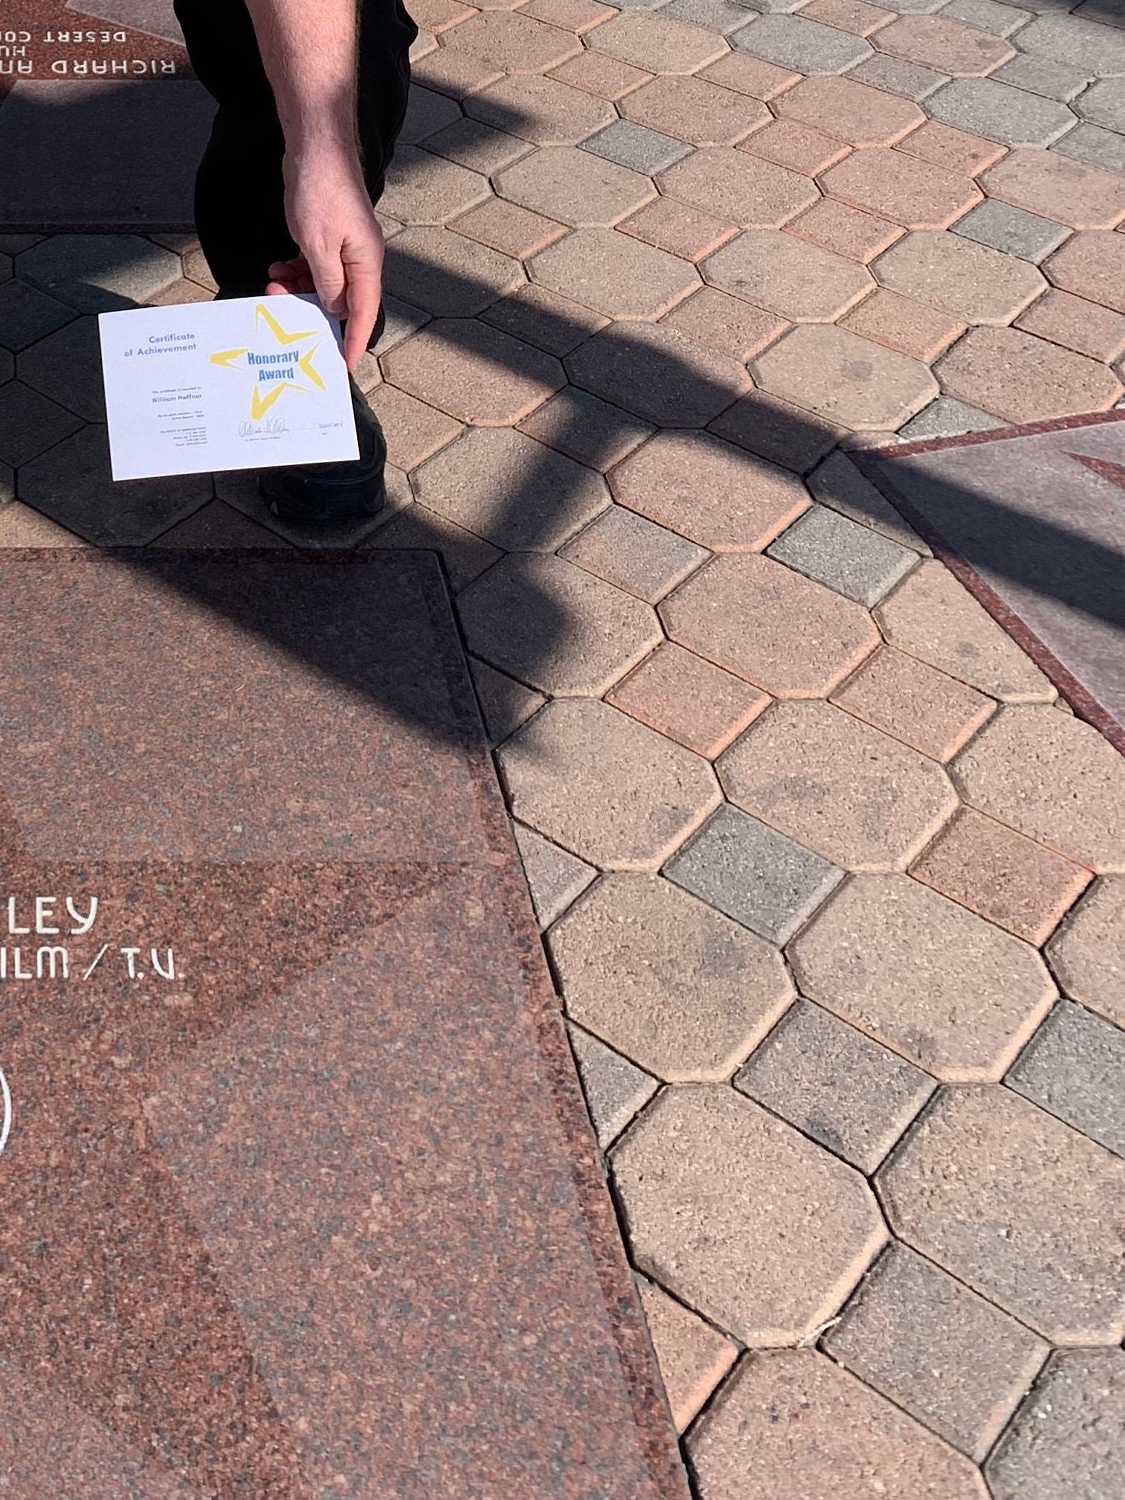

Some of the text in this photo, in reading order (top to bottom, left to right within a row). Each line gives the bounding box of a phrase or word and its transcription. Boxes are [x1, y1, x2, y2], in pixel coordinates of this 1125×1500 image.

[43, 31, 126, 42] DESERT
[51, 59, 175, 74] RICHARD
[148, 333, 195, 343] Certificate
[124, 343, 196, 357] of Achievement
[247, 350, 299, 364] Honorary
[259, 367, 294, 381] Award
[151, 395, 176, 403] William
